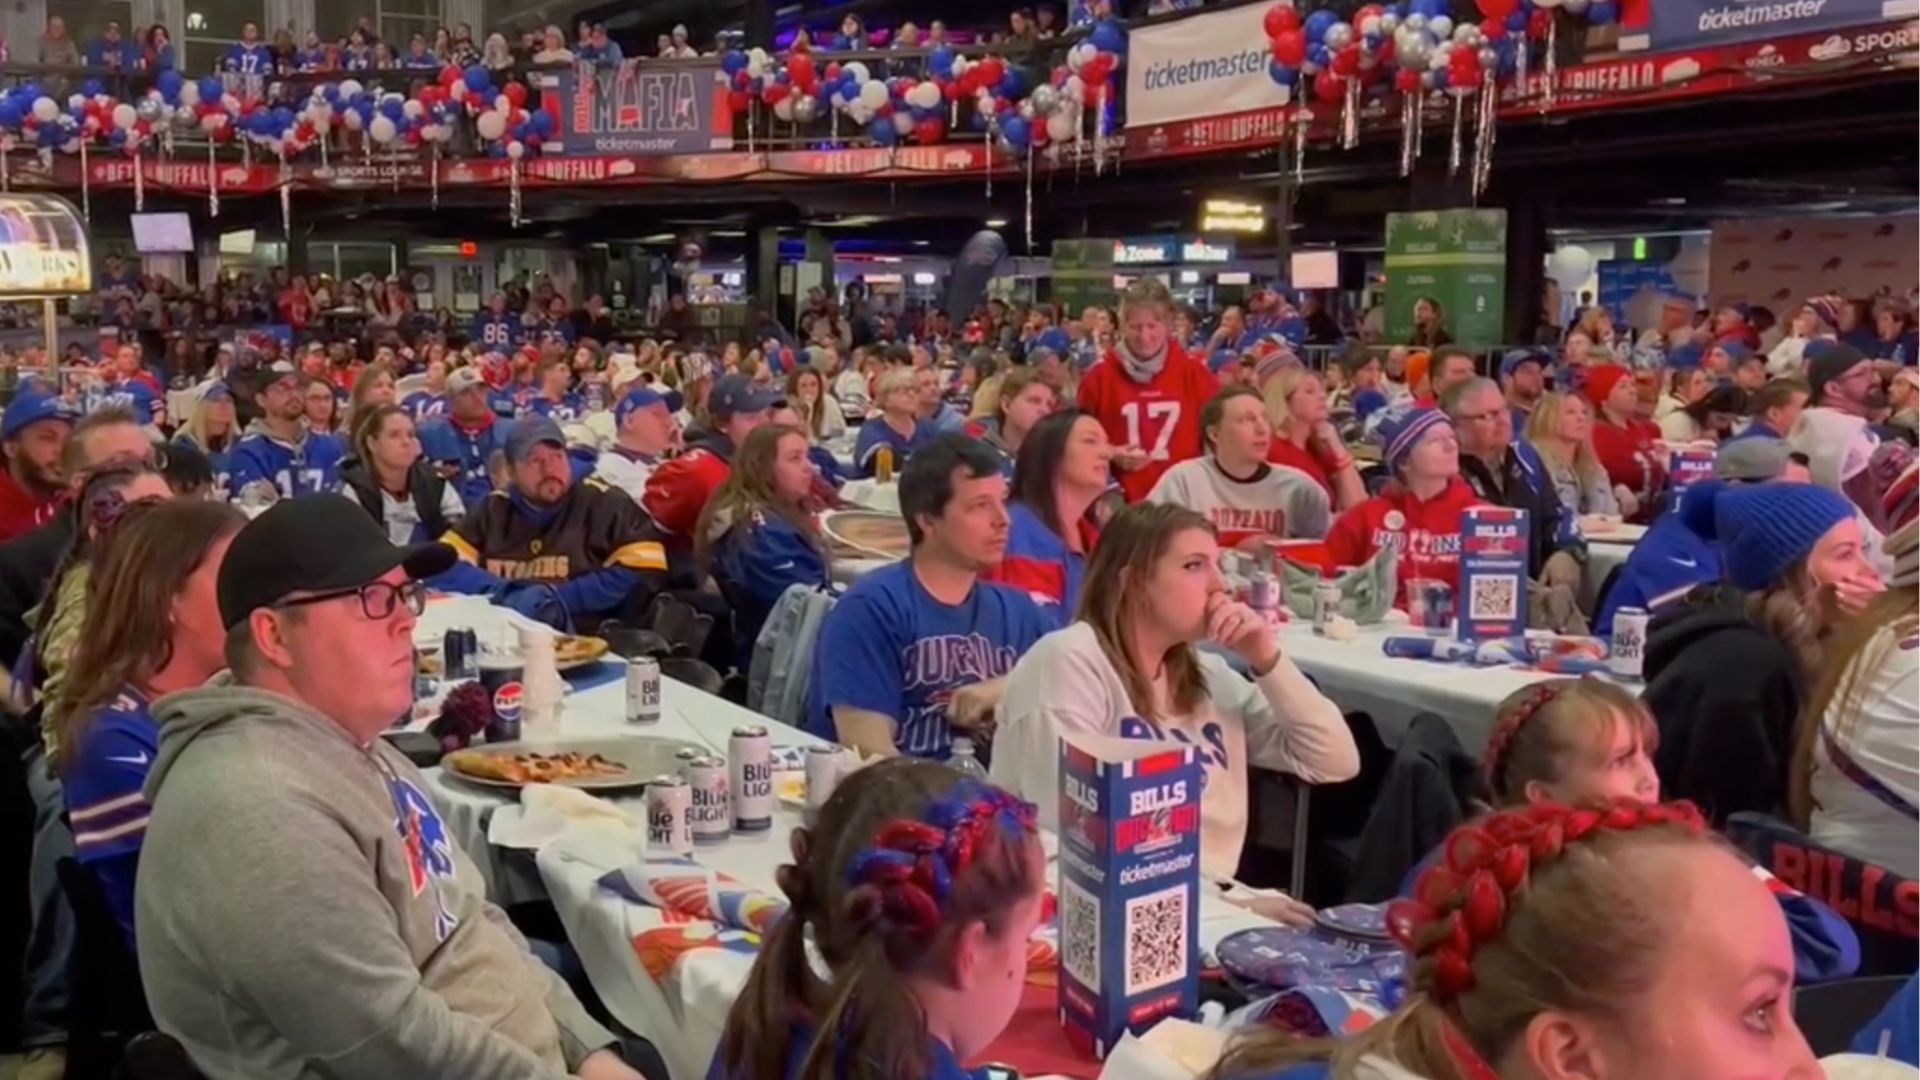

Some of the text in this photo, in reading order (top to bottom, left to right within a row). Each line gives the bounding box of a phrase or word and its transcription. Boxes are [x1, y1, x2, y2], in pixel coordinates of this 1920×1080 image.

[1698, 0, 1826, 31] ticketmaster
[241, 54, 258, 73] 17
[1144, 50, 1271, 90] ticketmaster
[592, 71, 699, 133] MAFIA
[595, 137, 677, 151] ticketmaster
[484, 322, 509, 344] 86
[1121, 401, 1181, 460] 17
[1129, 779, 1188, 817] BILLS
[1119, 853, 1195, 886] ticketmaster
